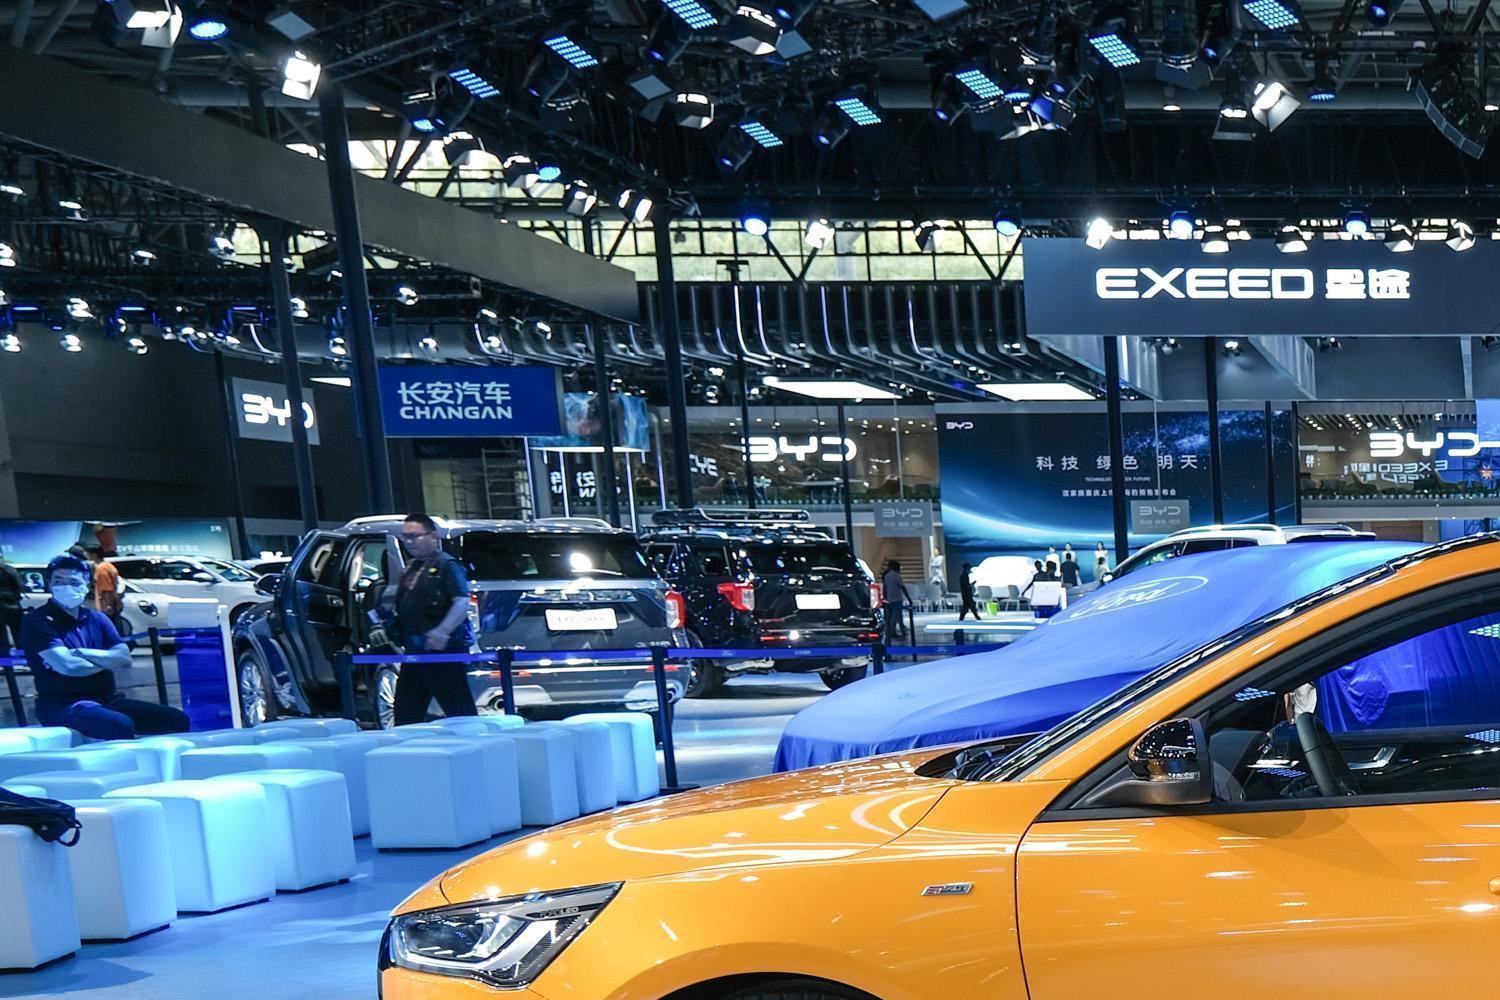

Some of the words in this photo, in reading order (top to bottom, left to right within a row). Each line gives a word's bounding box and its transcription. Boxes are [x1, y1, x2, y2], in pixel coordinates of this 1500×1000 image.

[1095, 267, 1314, 300] EXEED
[1324, 268, 1411, 300] 星途
[397, 381, 512, 404] 长安汽车
[399, 405, 513, 420] CHANGAN
[945, 421, 974, 430] BYD
[740, 436, 857, 462] BYD
[1369, 432, 1481, 458] BYD
[1036, 455, 1079, 471] 科技
[1157, 455, 1198, 471] 明天
[882, 507, 924, 518] BYD
[1138, 506, 1181, 516] BYD
